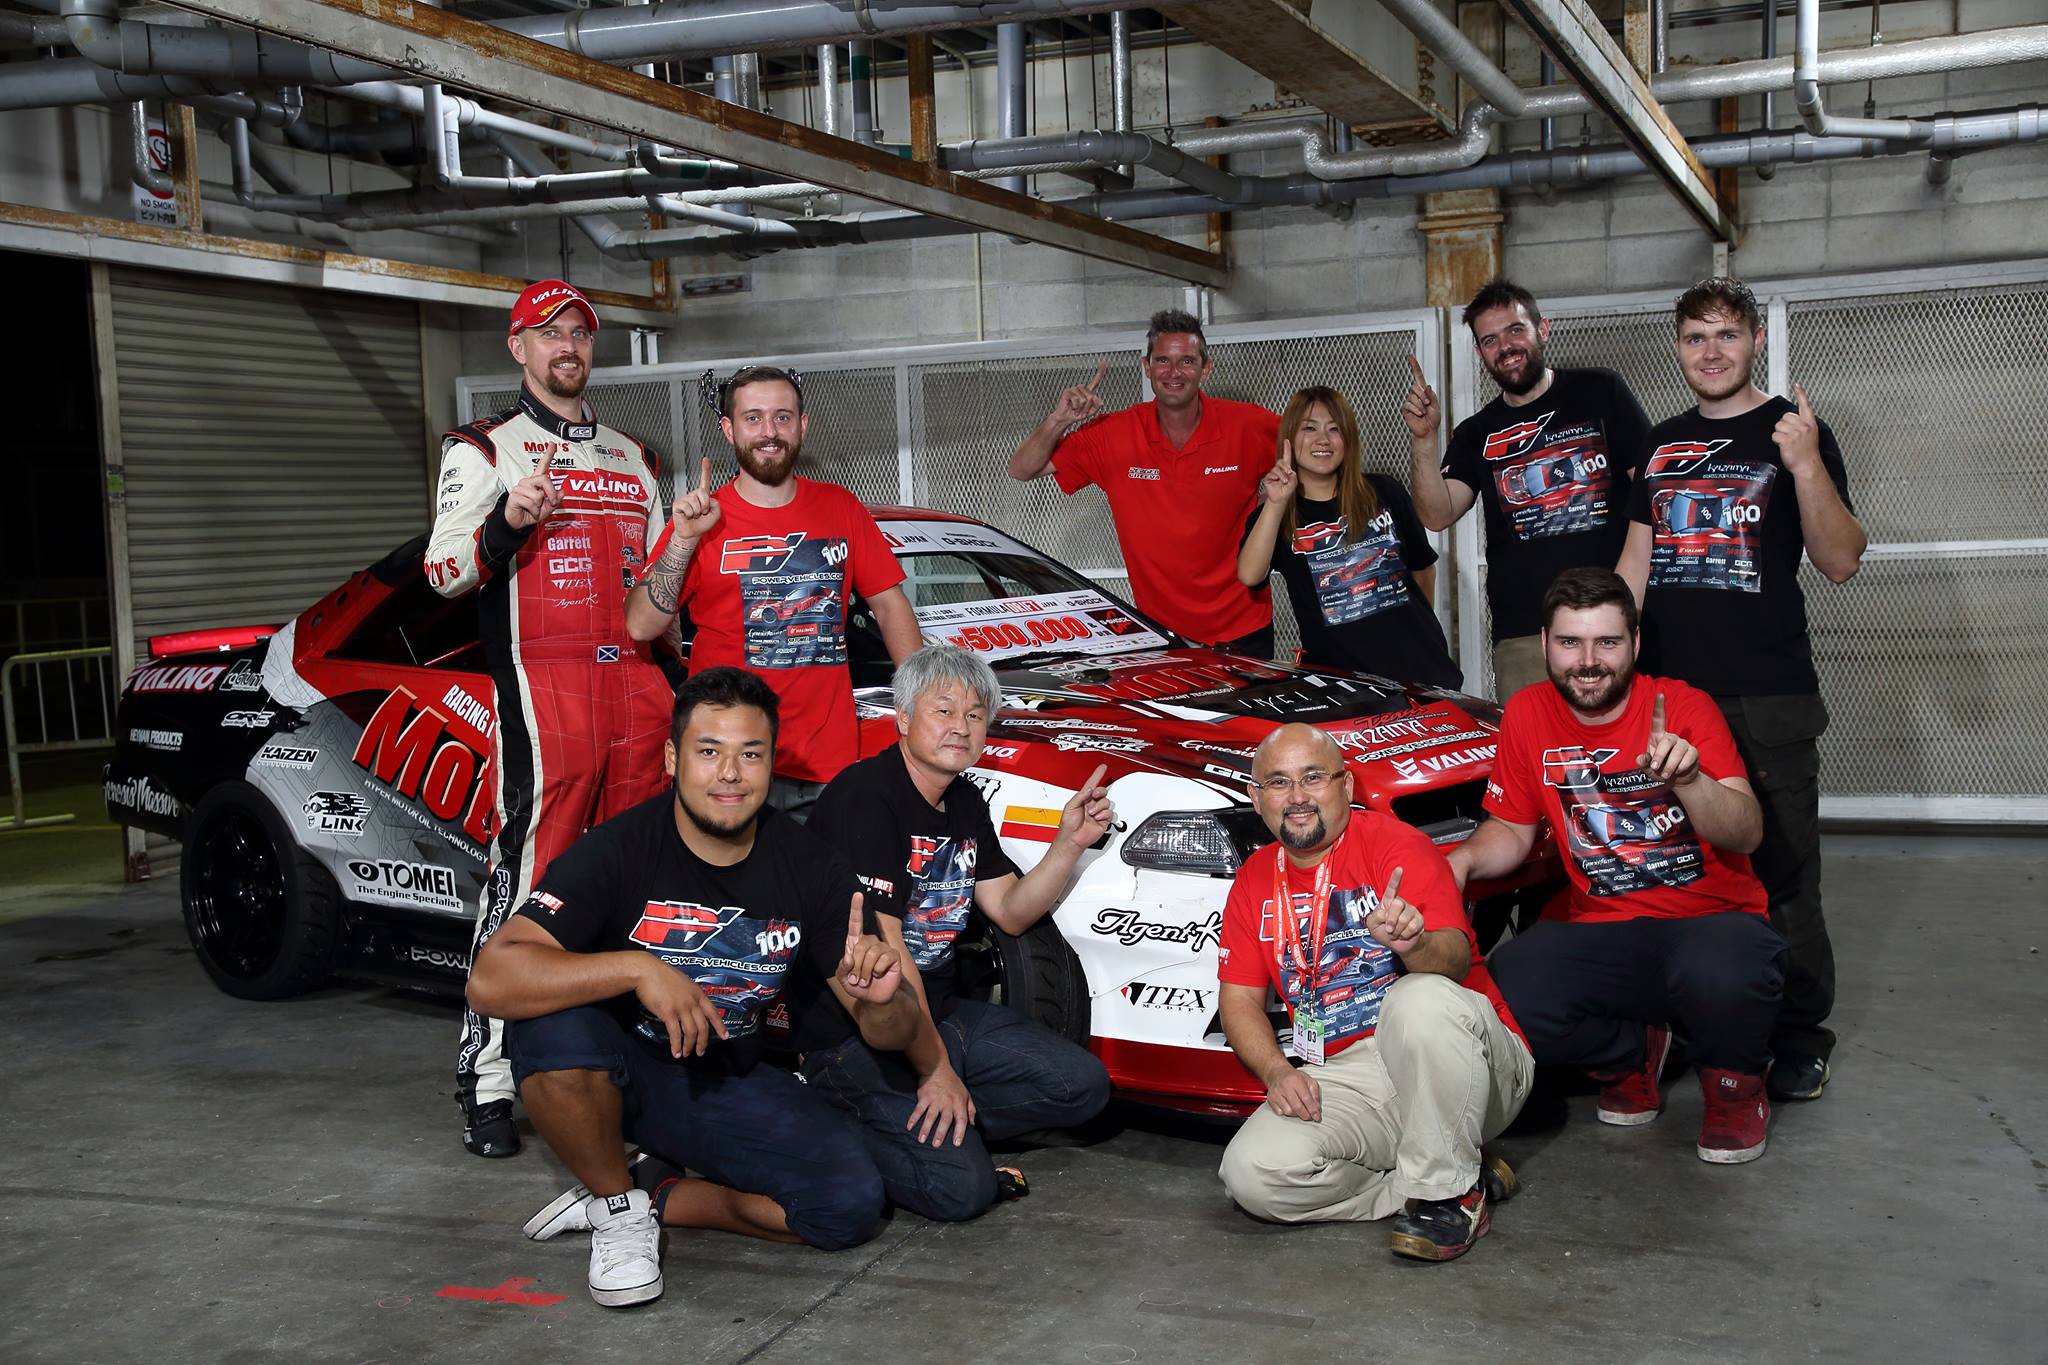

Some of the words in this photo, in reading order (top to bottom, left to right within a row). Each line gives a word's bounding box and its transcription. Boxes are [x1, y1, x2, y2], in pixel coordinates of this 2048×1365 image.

[141, 199, 151, 207] NO
[1211, 465, 1239, 474] VALINO
[1573, 453, 1608, 477] 100
[570, 477, 640, 496] VALINO
[1368, 510, 1393, 533] 100
[1700, 507, 1712, 521] 100
[1722, 504, 1761, 526] 100
[547, 537, 592, 551] Garrett
[821, 542, 849, 566] 100
[548, 557, 593, 575] GCG
[1734, 560, 1753, 568] GCG
[965, 603, 1007, 617] FORMULA
[133, 667, 228, 692] VALINO
[441, 684, 492, 735] RACING
[150, 731, 184, 747] PRODUCTS
[321, 817, 364, 833] LINK
[1621, 818, 1635, 832] 100
[1646, 806, 1685, 835] 100
[391, 796, 419, 821] MOTOR
[418, 815, 432, 831] OIL
[433, 825, 490, 864] TECHNOLOGY
[1677, 854, 1695, 864] GCG
[378, 862, 454, 897] TOMEI
[873, 877, 894, 893] DRIFT
[357, 885, 376, 895] The
[377, 887, 411, 900] Engine
[412, 892, 461, 909] Specialist
[755, 925, 802, 957] 100
[1142, 985, 1216, 1009] TEX
[1142, 1003, 1208, 1013] MODIFY
[1307, 1030, 1317, 1044] 03
